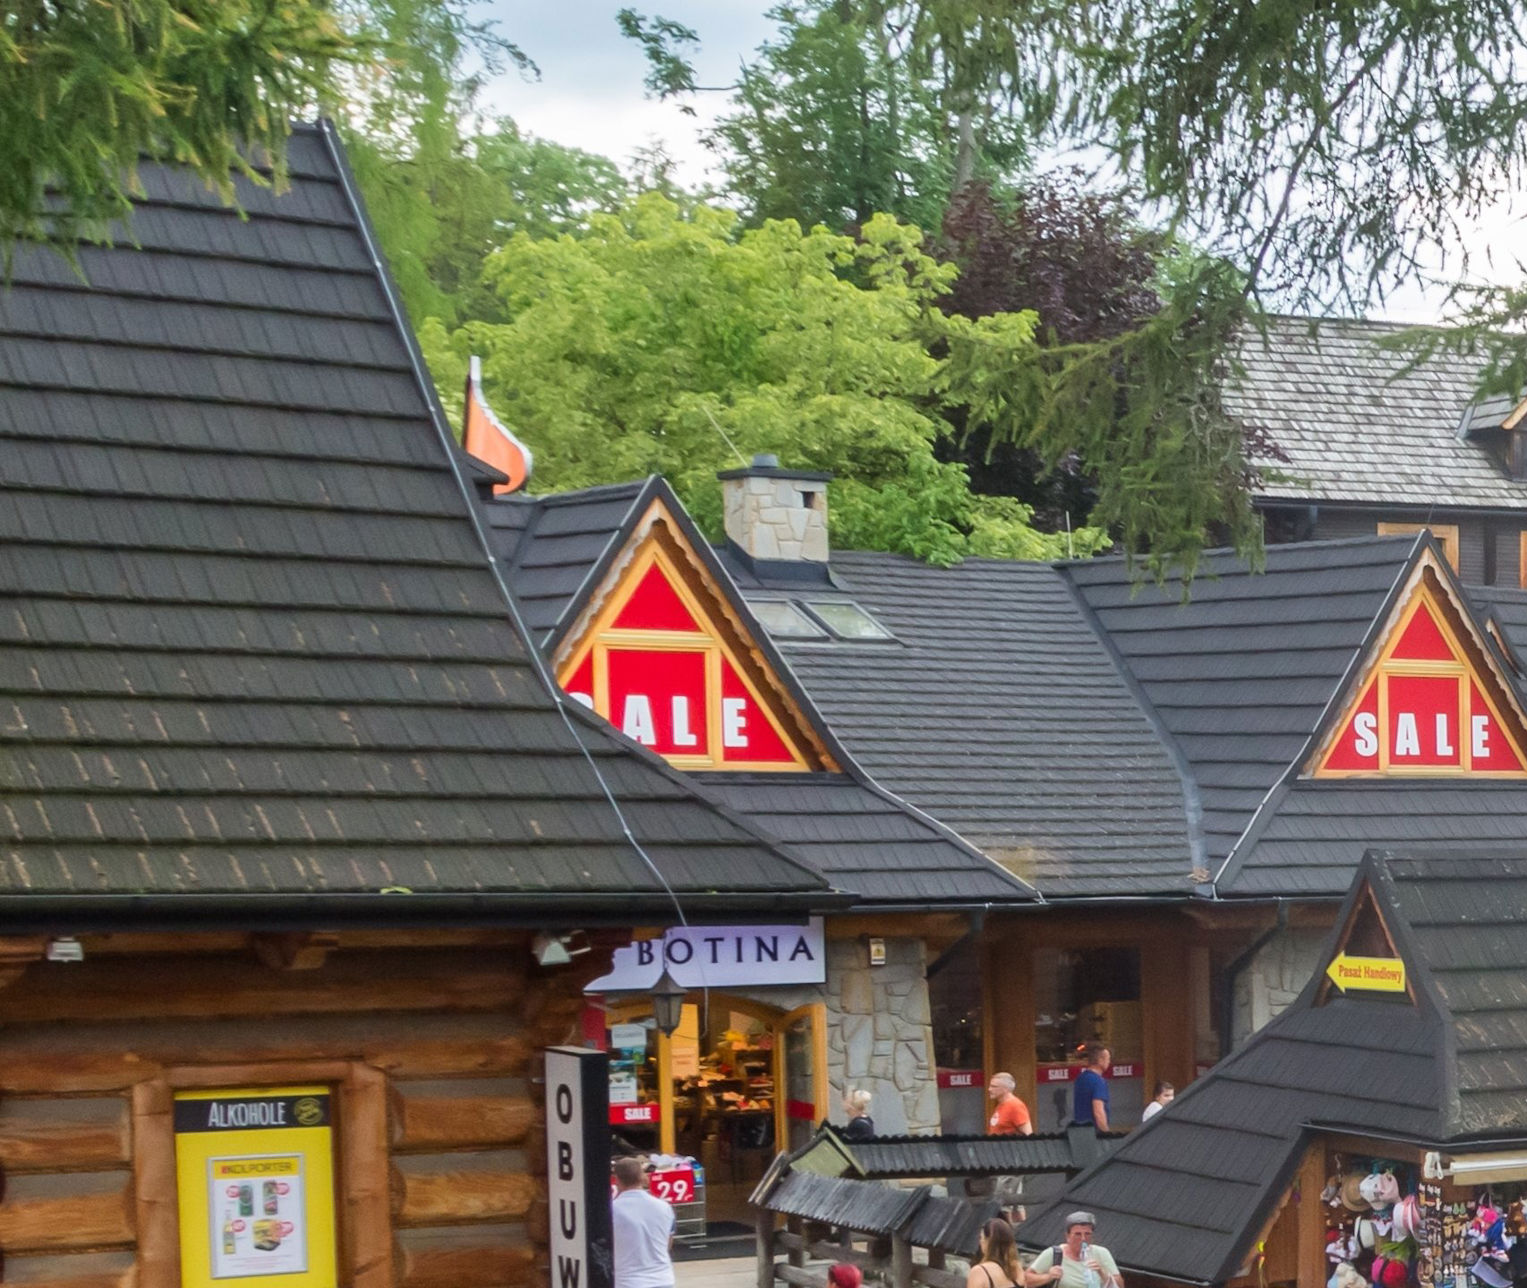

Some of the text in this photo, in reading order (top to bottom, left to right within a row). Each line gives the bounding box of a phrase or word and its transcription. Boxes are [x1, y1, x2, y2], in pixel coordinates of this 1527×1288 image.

[1353, 711, 1491, 758] SALE
[637, 936, 815, 966] BOTINA
[1048, 1069, 1070, 1080] SALE
[1112, 1065, 1133, 1077] SALE
[949, 1074, 972, 1086] SALE
[208, 1101, 286, 1128] ALKOHOLE
[624, 1107, 652, 1120] SALE
